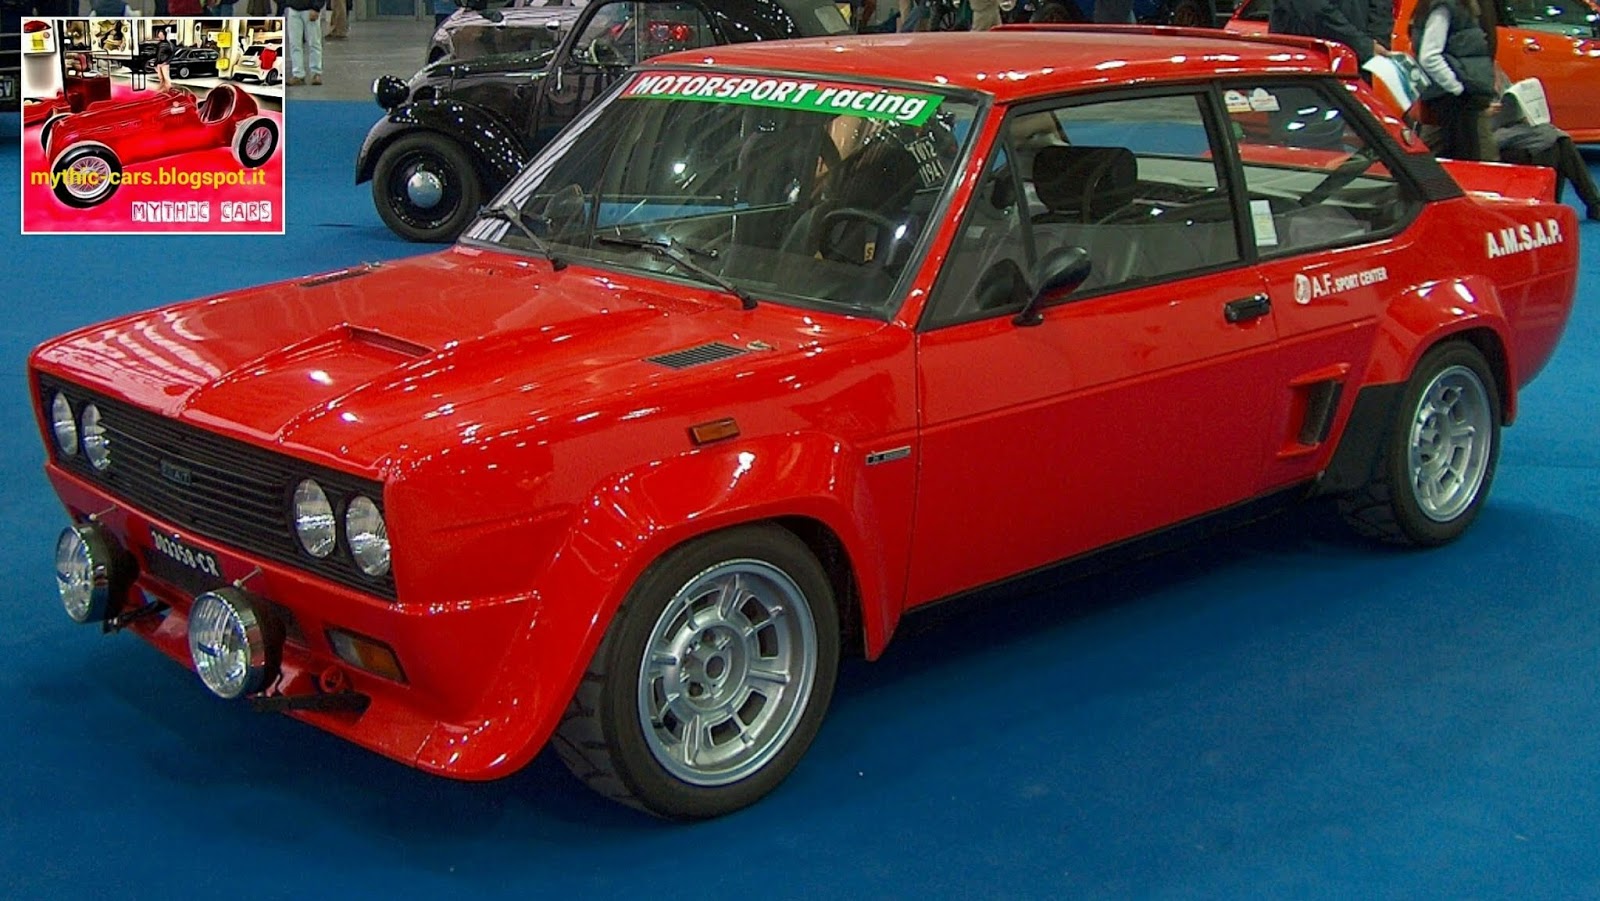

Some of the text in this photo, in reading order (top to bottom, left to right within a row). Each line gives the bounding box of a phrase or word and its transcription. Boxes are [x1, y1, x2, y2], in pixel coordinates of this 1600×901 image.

[630, 75, 928, 121] MOTORSPORT racing
[1486, 219, 1563, 259] A.M.S.A.P.
[1334, 273, 1360, 293] SPORT
